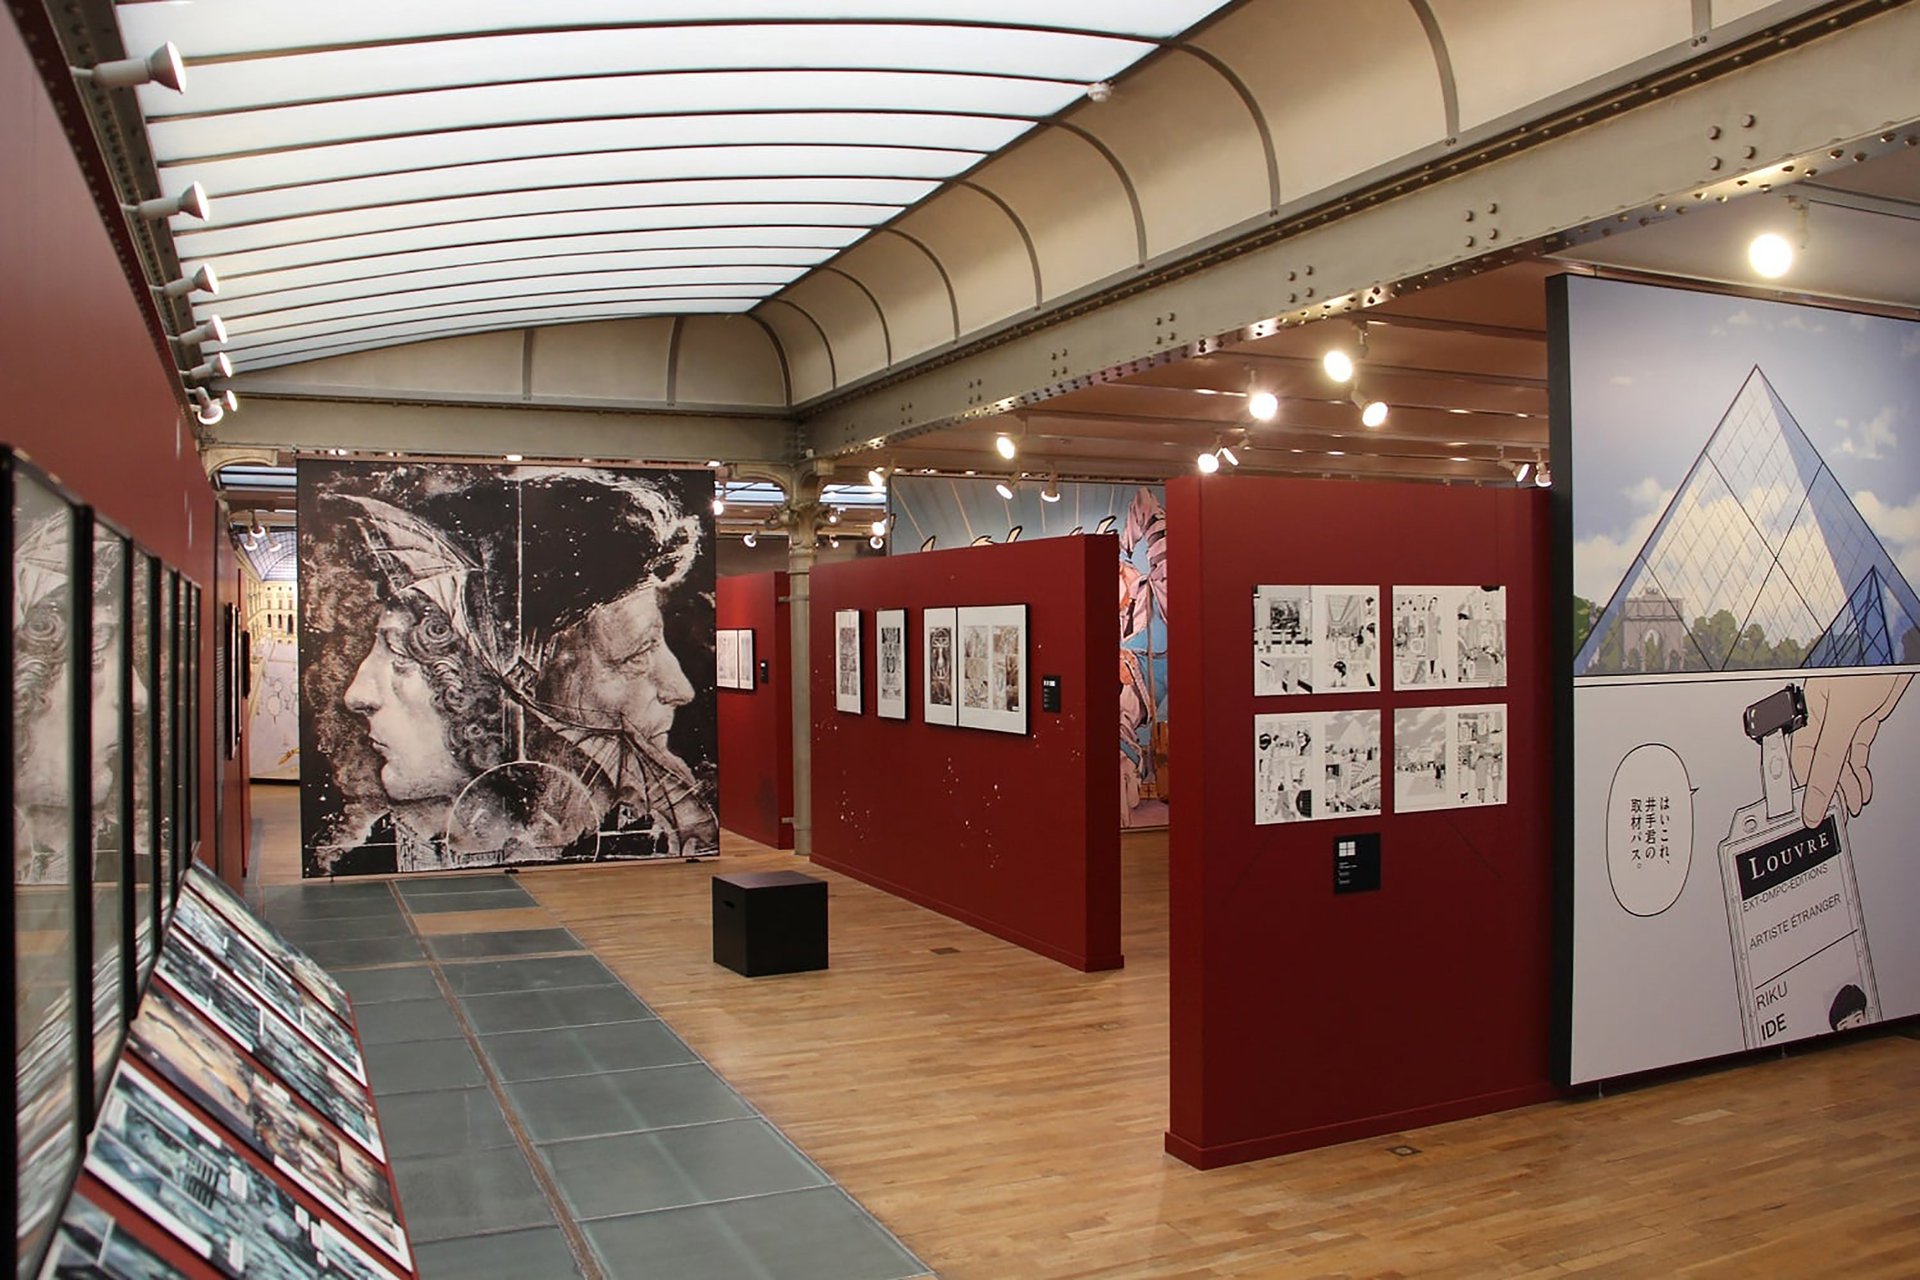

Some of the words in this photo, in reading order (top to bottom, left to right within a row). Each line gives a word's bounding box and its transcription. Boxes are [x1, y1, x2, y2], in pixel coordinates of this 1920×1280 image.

[1749, 832, 1830, 880] LOUVRE
[1750, 920, 1789, 949] ARTISTE
[1791, 893, 1841, 929] ÉTRANGER
[1756, 981, 1788, 1010] RIKU
[1761, 1013, 1787, 1041] IDE
